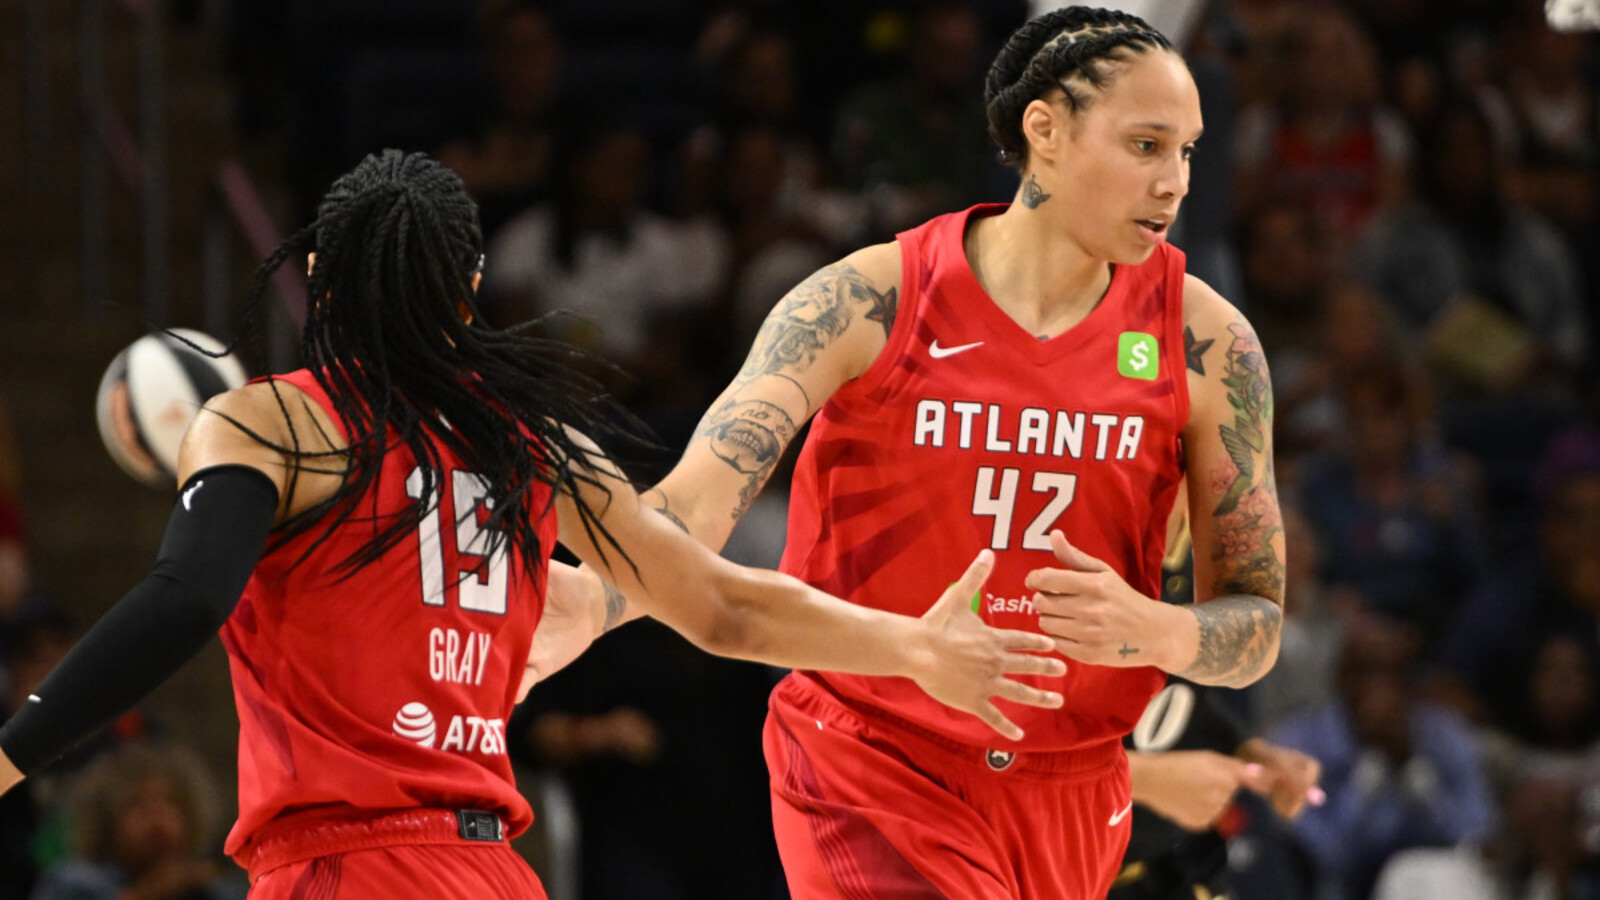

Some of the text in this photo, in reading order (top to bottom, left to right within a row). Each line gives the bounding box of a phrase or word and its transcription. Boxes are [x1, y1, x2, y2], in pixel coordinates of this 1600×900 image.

[913, 399, 1144, 460] ATLANTA
[972, 466, 1077, 551] 42
[406, 465, 508, 615] 15
[429, 627, 491, 685] GRAY
[441, 715, 505, 754] AT&T
